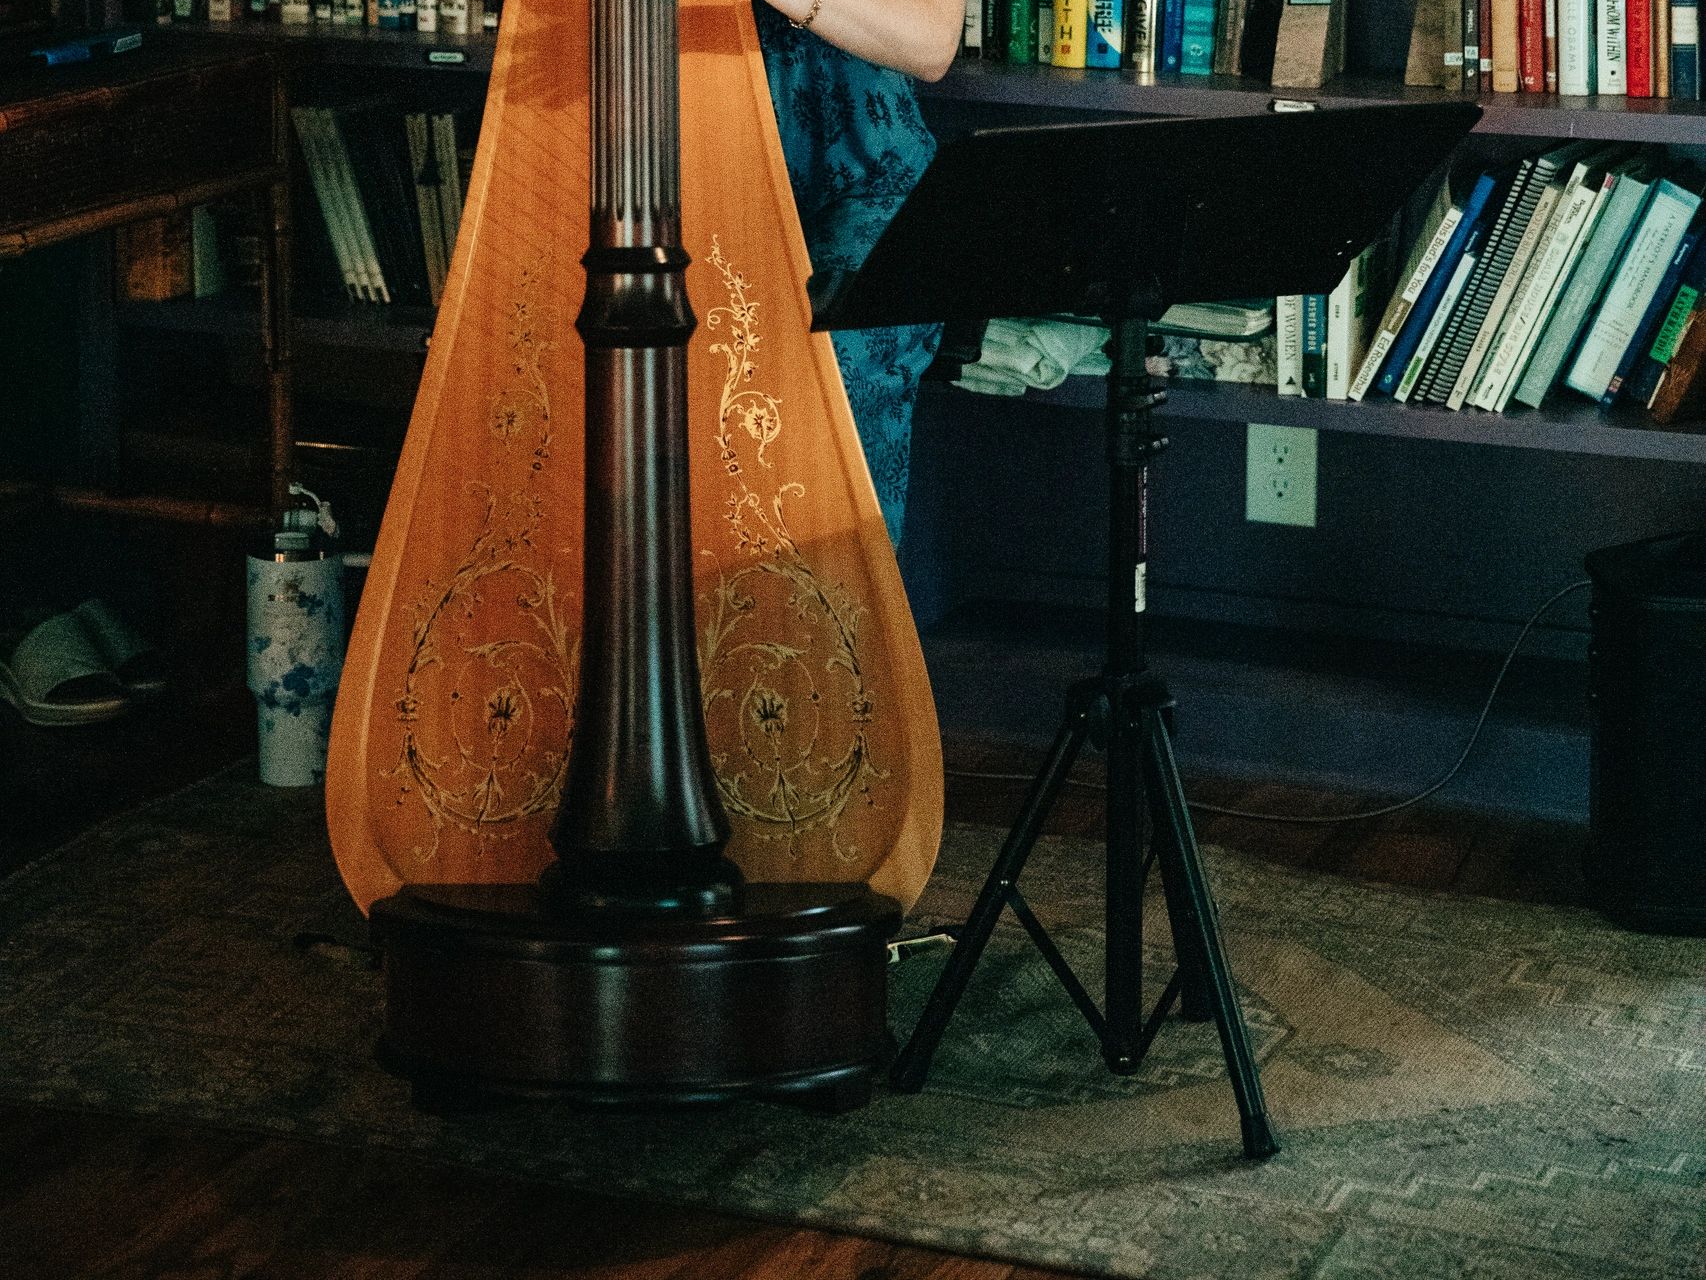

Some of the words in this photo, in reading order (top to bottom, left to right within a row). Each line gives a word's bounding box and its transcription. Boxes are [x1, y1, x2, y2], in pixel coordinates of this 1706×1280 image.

[1135, 0, 1147, 40] GIVE
[1466, 9, 1474, 33] POWELL
[1566, 27, 1576, 72] OBAMA
[1438, 218, 1456, 238] This
[1534, 207, 1550, 228] NOT
[1551, 210, 1570, 229] THE
[1424, 237, 1446, 263] Bud's
[1528, 230, 1561, 280] KITCHEN
[1416, 262, 1431, 277] for
[1503, 257, 1528, 289] HOUSE
[1407, 277, 1424, 295] You
[1509, 281, 1535, 315] BOOK
[1626, 266, 1653, 311] HANDBOOK
[1284, 313, 1296, 362] WOMEN
[1378, 335, 1391, 350] Ed
[1352, 348, 1384, 395] Rosenthal
